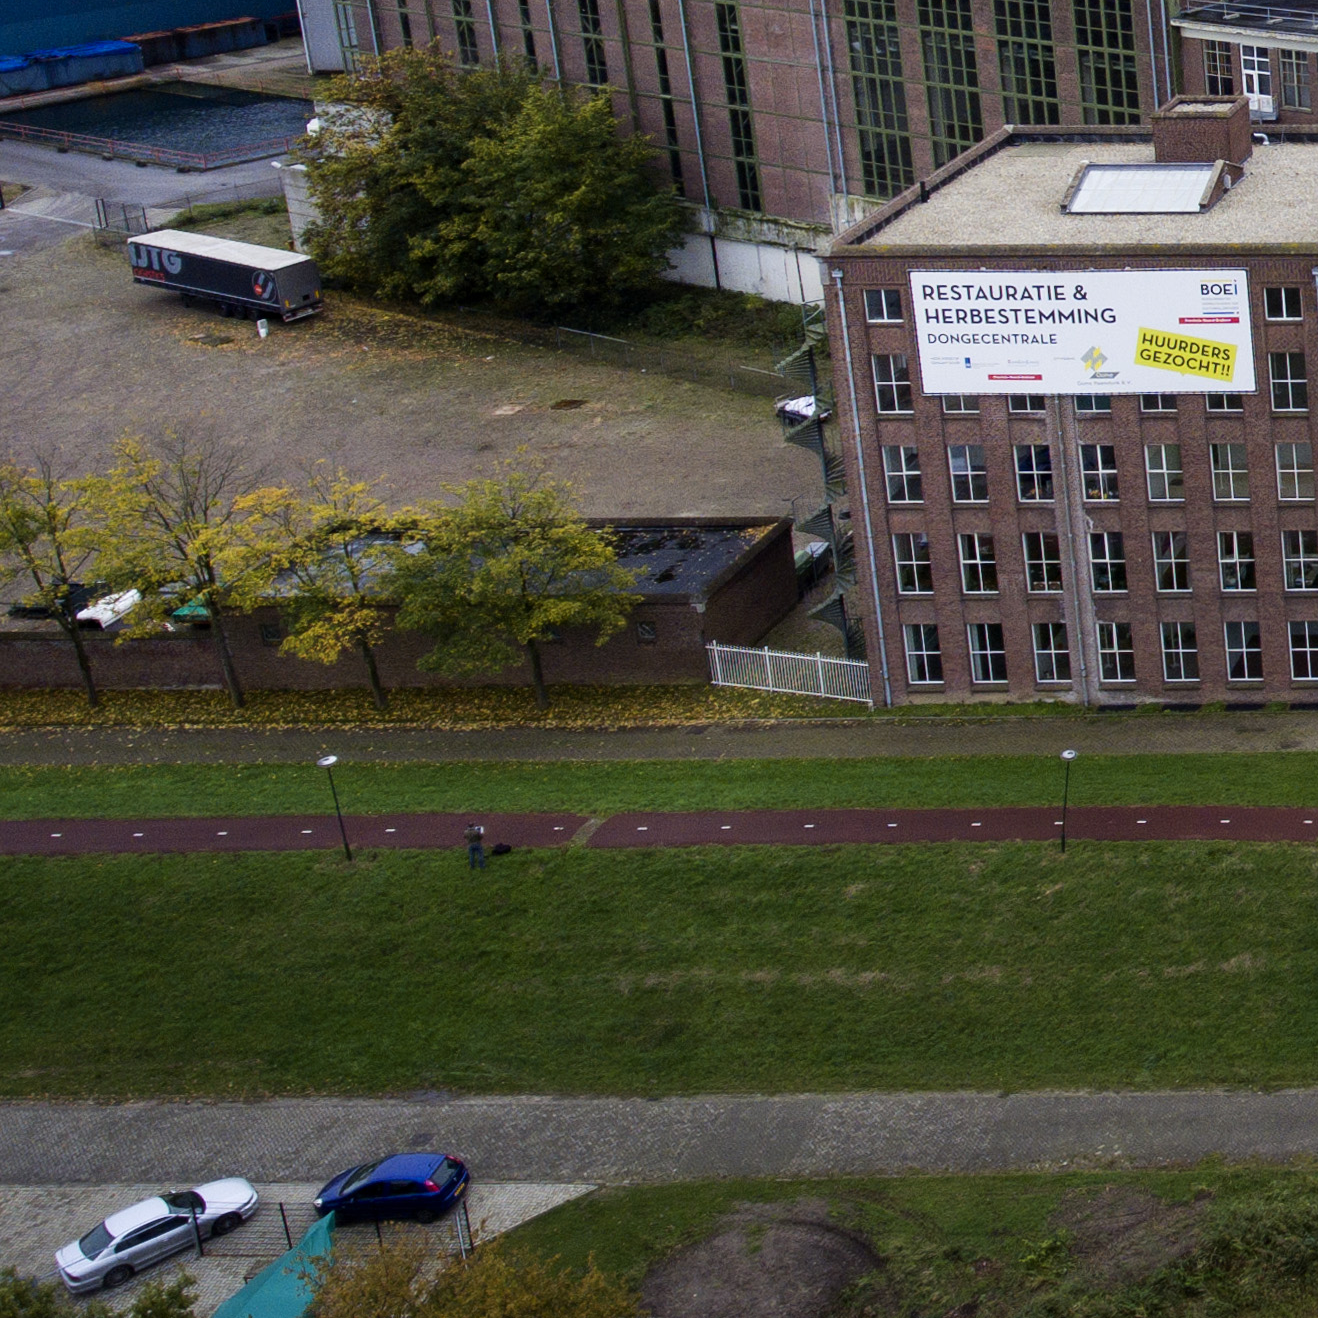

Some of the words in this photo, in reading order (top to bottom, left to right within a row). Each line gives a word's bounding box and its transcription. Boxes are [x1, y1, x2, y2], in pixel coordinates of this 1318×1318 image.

[922, 284, 1066, 301] RESTAURATIE
[1072, 284, 1088, 301] &
[924, 307, 1117, 325] HERBESTEMMING
[927, 333, 1058, 345] DONGECENTRALE
[1142, 332, 1231, 361] HUURDERS
[1140, 348, 1231, 377] GEZOCHT!!
